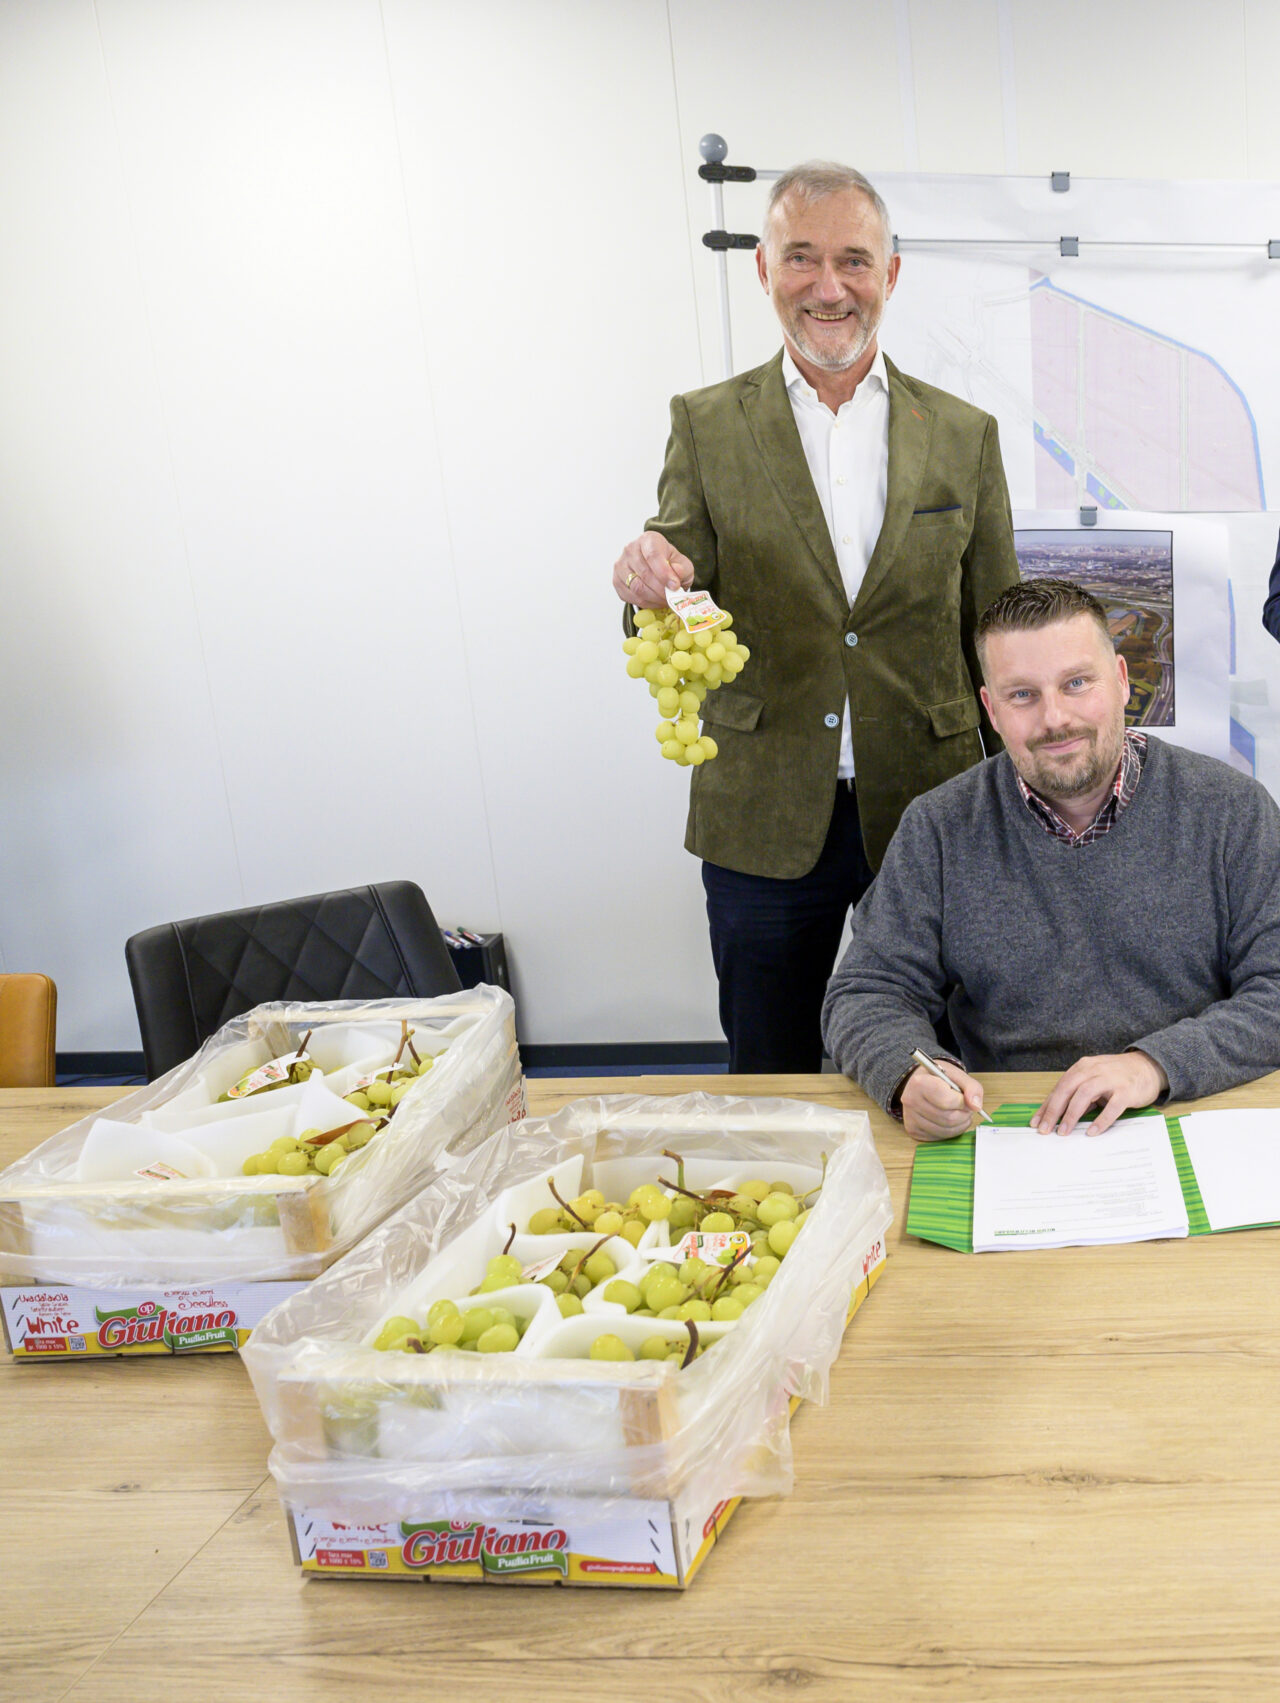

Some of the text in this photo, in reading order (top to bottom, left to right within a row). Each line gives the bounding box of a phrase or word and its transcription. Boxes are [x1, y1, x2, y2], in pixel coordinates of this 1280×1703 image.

[26, 1316, 79, 1334] White
[98, 1310, 237, 1348] Giuliano
[402, 1525, 567, 1566] Giuliano
